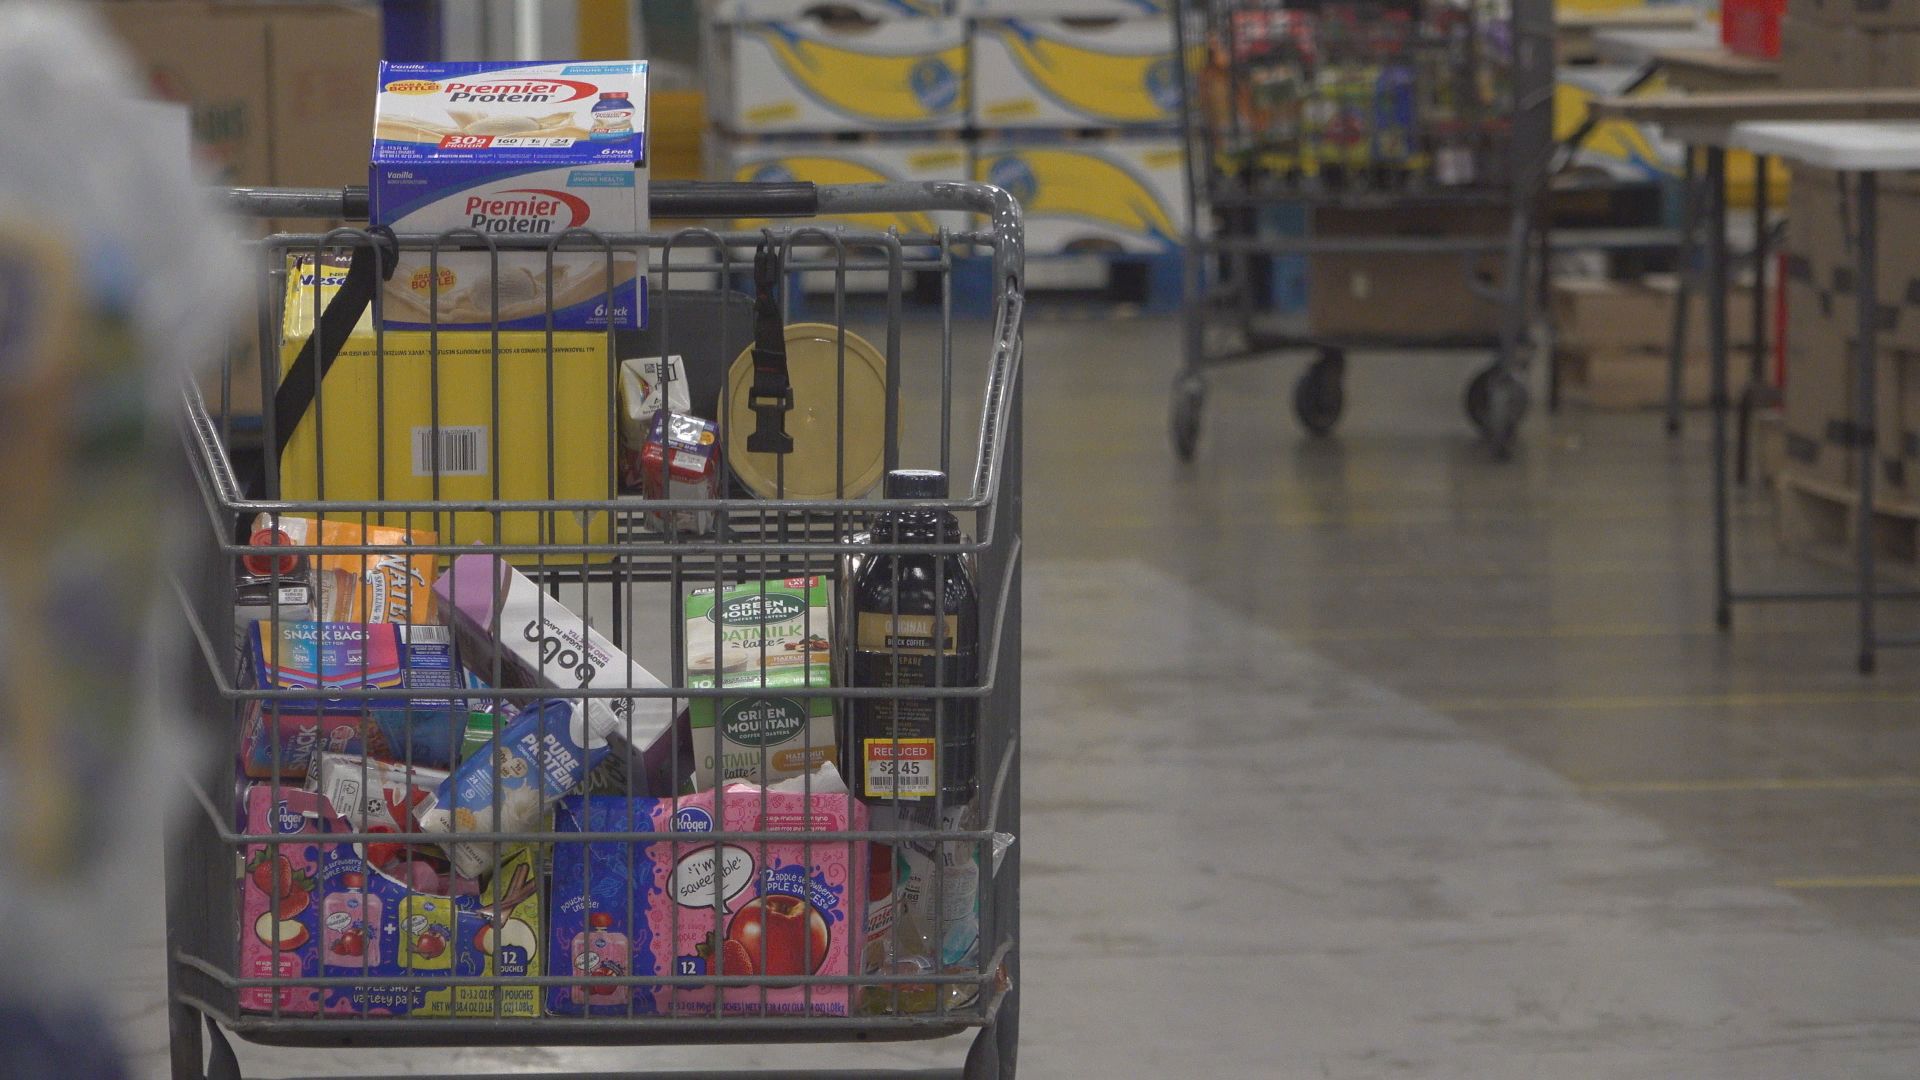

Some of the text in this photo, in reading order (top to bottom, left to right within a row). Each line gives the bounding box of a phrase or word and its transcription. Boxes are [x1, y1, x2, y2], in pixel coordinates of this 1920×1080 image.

[445, 83, 562, 94] Premier
[450, 92, 549, 103] Protein
[448, 136, 487, 145] 30g
[387, 171, 413, 179] Vanilla
[465, 196, 560, 216] Premier
[471, 214, 552, 233] Protein
[411, 276, 456, 290] BOTLE!
[594, 303, 604, 316] 6
[374, 576, 384, 613] SPARKLING
[729, 600, 784, 611] GREEN
[543, 617, 564, 637] FLAVO
[885, 620, 928, 634] OIGINAL
[283, 629, 331, 640] SNACK
[568, 628, 580, 641] TEA
[562, 634, 583, 652] SUGAR
[906, 639, 925, 647] COFFEE
[593, 649, 610, 664] TARO
[692, 680, 712, 688] 10
[544, 733, 580, 773] PURE
[785, 750, 825, 760] HAZENUT
[873, 747, 928, 756] REDUCED
[704, 752, 761, 770] OTMIL
[724, 768, 749, 780] latte
[879, 761, 920, 775] $2.45
[676, 813, 708, 833] Kroger
[330, 849, 338, 860] 6
[680, 857, 742, 897] squeeble"
[765, 882, 825, 906] PPLE SACES
[775, 873, 797, 883] apple
[798, 874, 838, 906] stawberry
[502, 951, 517, 964] 12
[680, 961, 696, 974] 12
[353, 994, 420, 1007] vaiety pak
[505, 990, 534, 1000] POUCHES
[431, 1001, 443, 1012] NET
